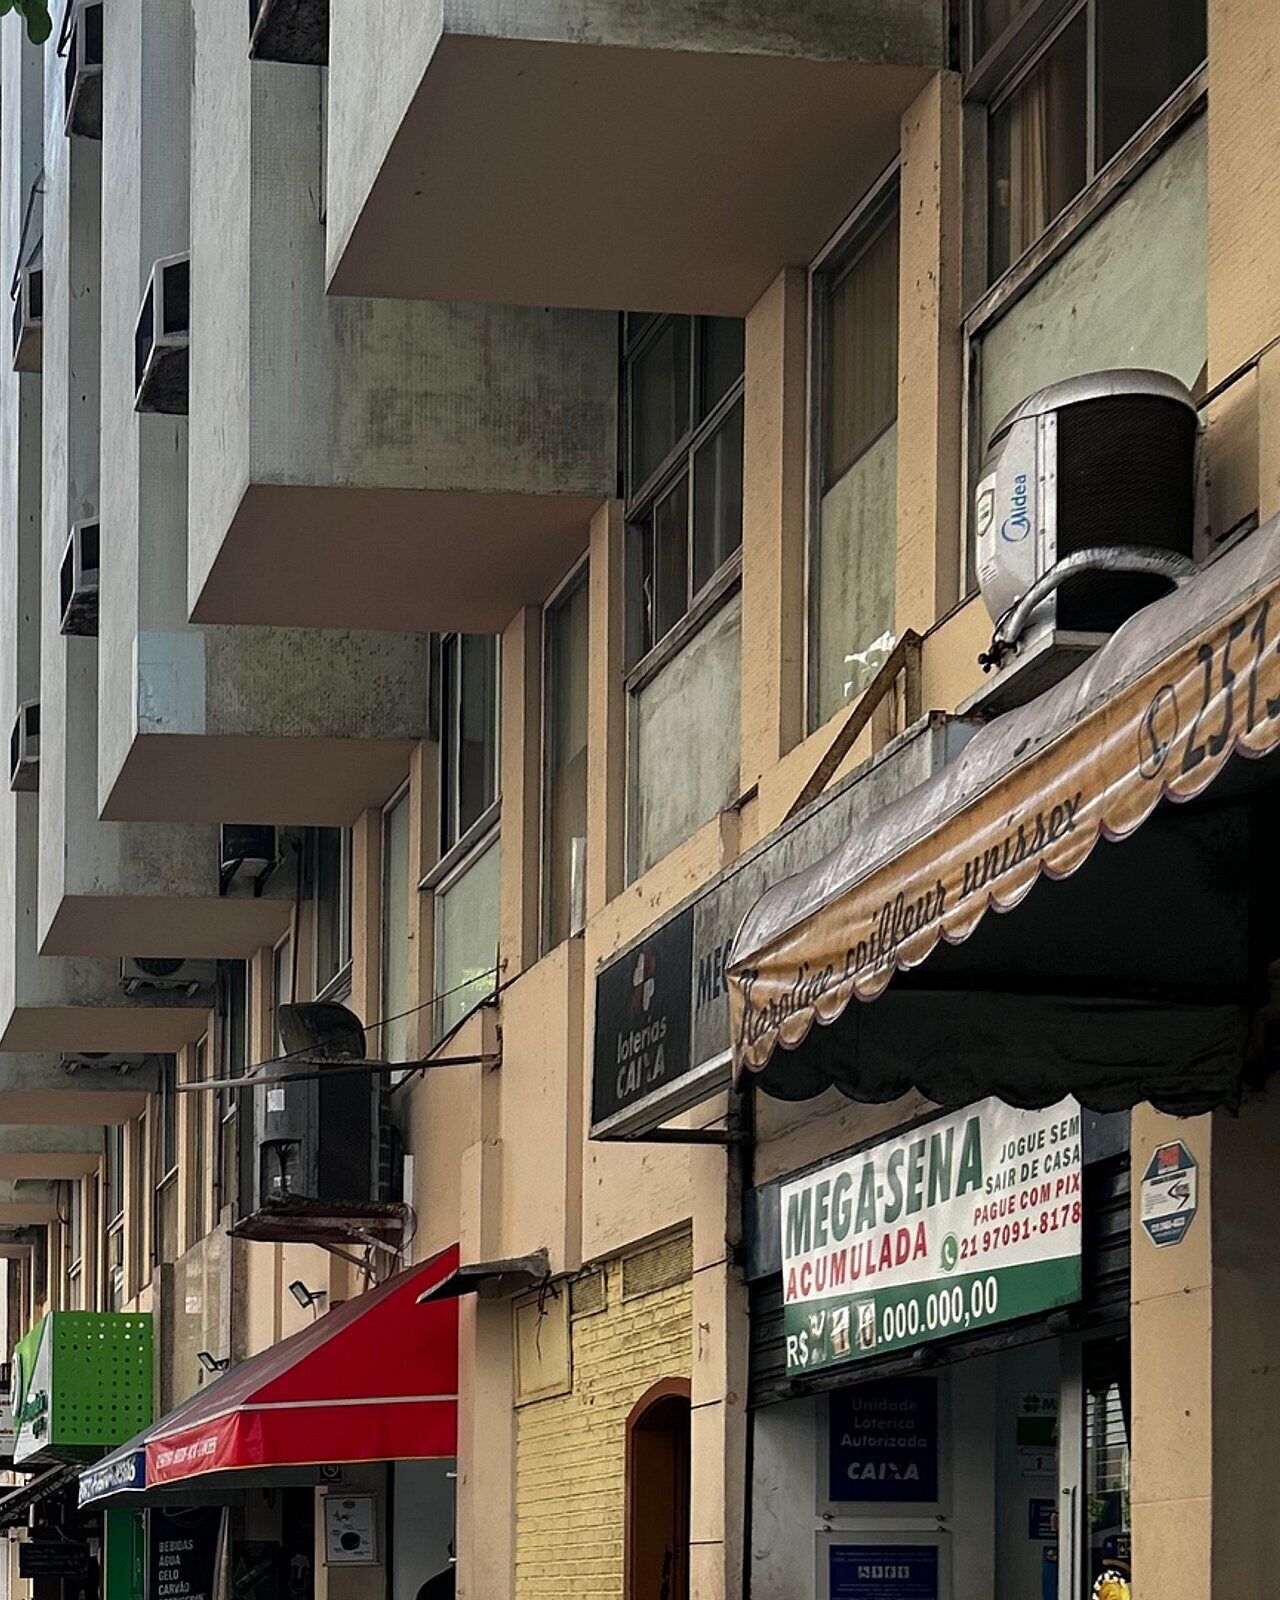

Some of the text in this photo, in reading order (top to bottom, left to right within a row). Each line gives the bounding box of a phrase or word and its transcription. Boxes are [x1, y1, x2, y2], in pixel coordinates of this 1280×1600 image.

[1006, 474, 1028, 531] Midea
[959, 792, 1083, 902] unissex
[617, 1015, 667, 1064] loterias
[1000, 1115, 1080, 1164] JOGUE SEM
[785, 1115, 983, 1259] MEGA-SENA
[985, 1144, 1081, 1196] SAIR DE CASA
[974, 1172, 1081, 1226] PAGUE COM PIX
[960, 1200, 1082, 1260] 21 97091-8178
[786, 1220, 928, 1303] ACUMULADA
[850, 1396, 919, 1411] Unidade
[840, 1433, 928, 1448] Autorizada
[847, 1462, 920, 1480] CAIXA
[158, 1539, 194, 1552] BEBIDAS
[158, 1569, 179, 1581] GELO
[158, 1582, 190, 1596] CARVÃO
